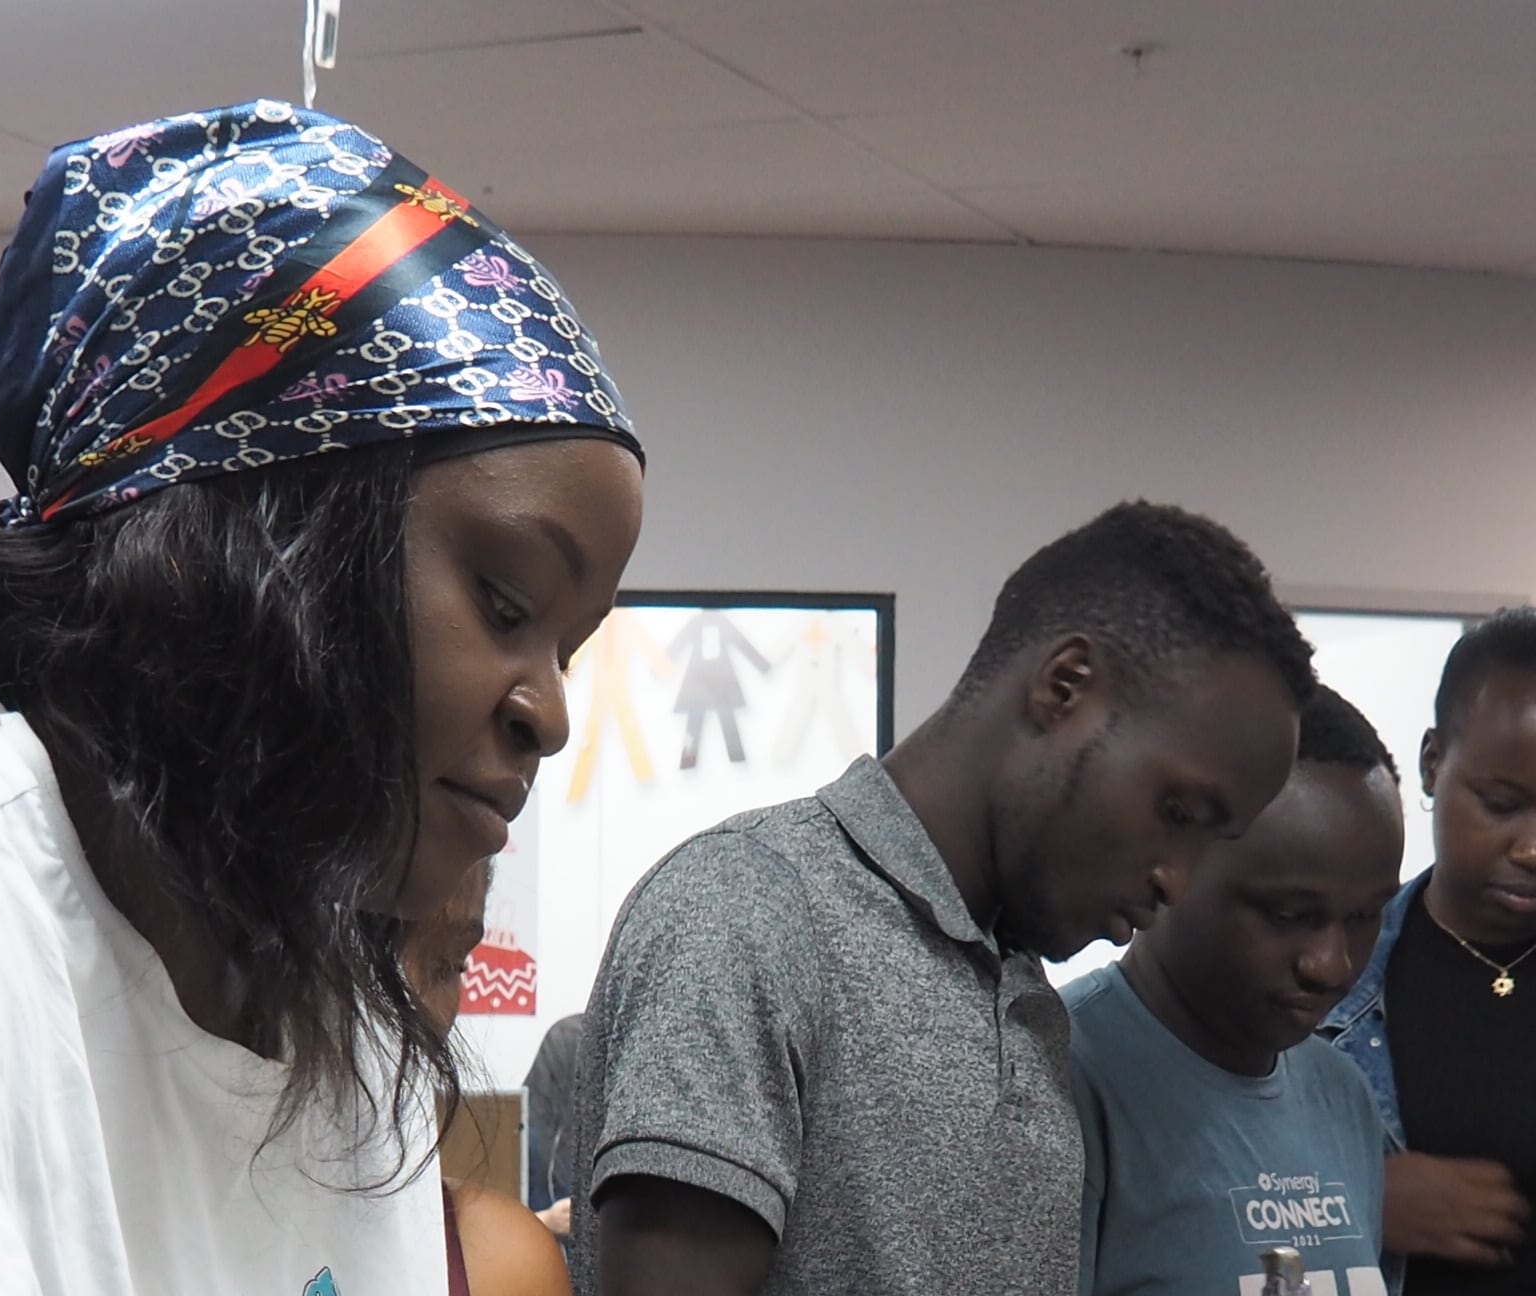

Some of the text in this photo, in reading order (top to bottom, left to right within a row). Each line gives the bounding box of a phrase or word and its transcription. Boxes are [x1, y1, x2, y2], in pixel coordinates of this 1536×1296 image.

[1270, 1172, 1320, 1196] Synergy
[1246, 1196, 1351, 1231] CONNECT
[1292, 1235, 1322, 1248] 2021
